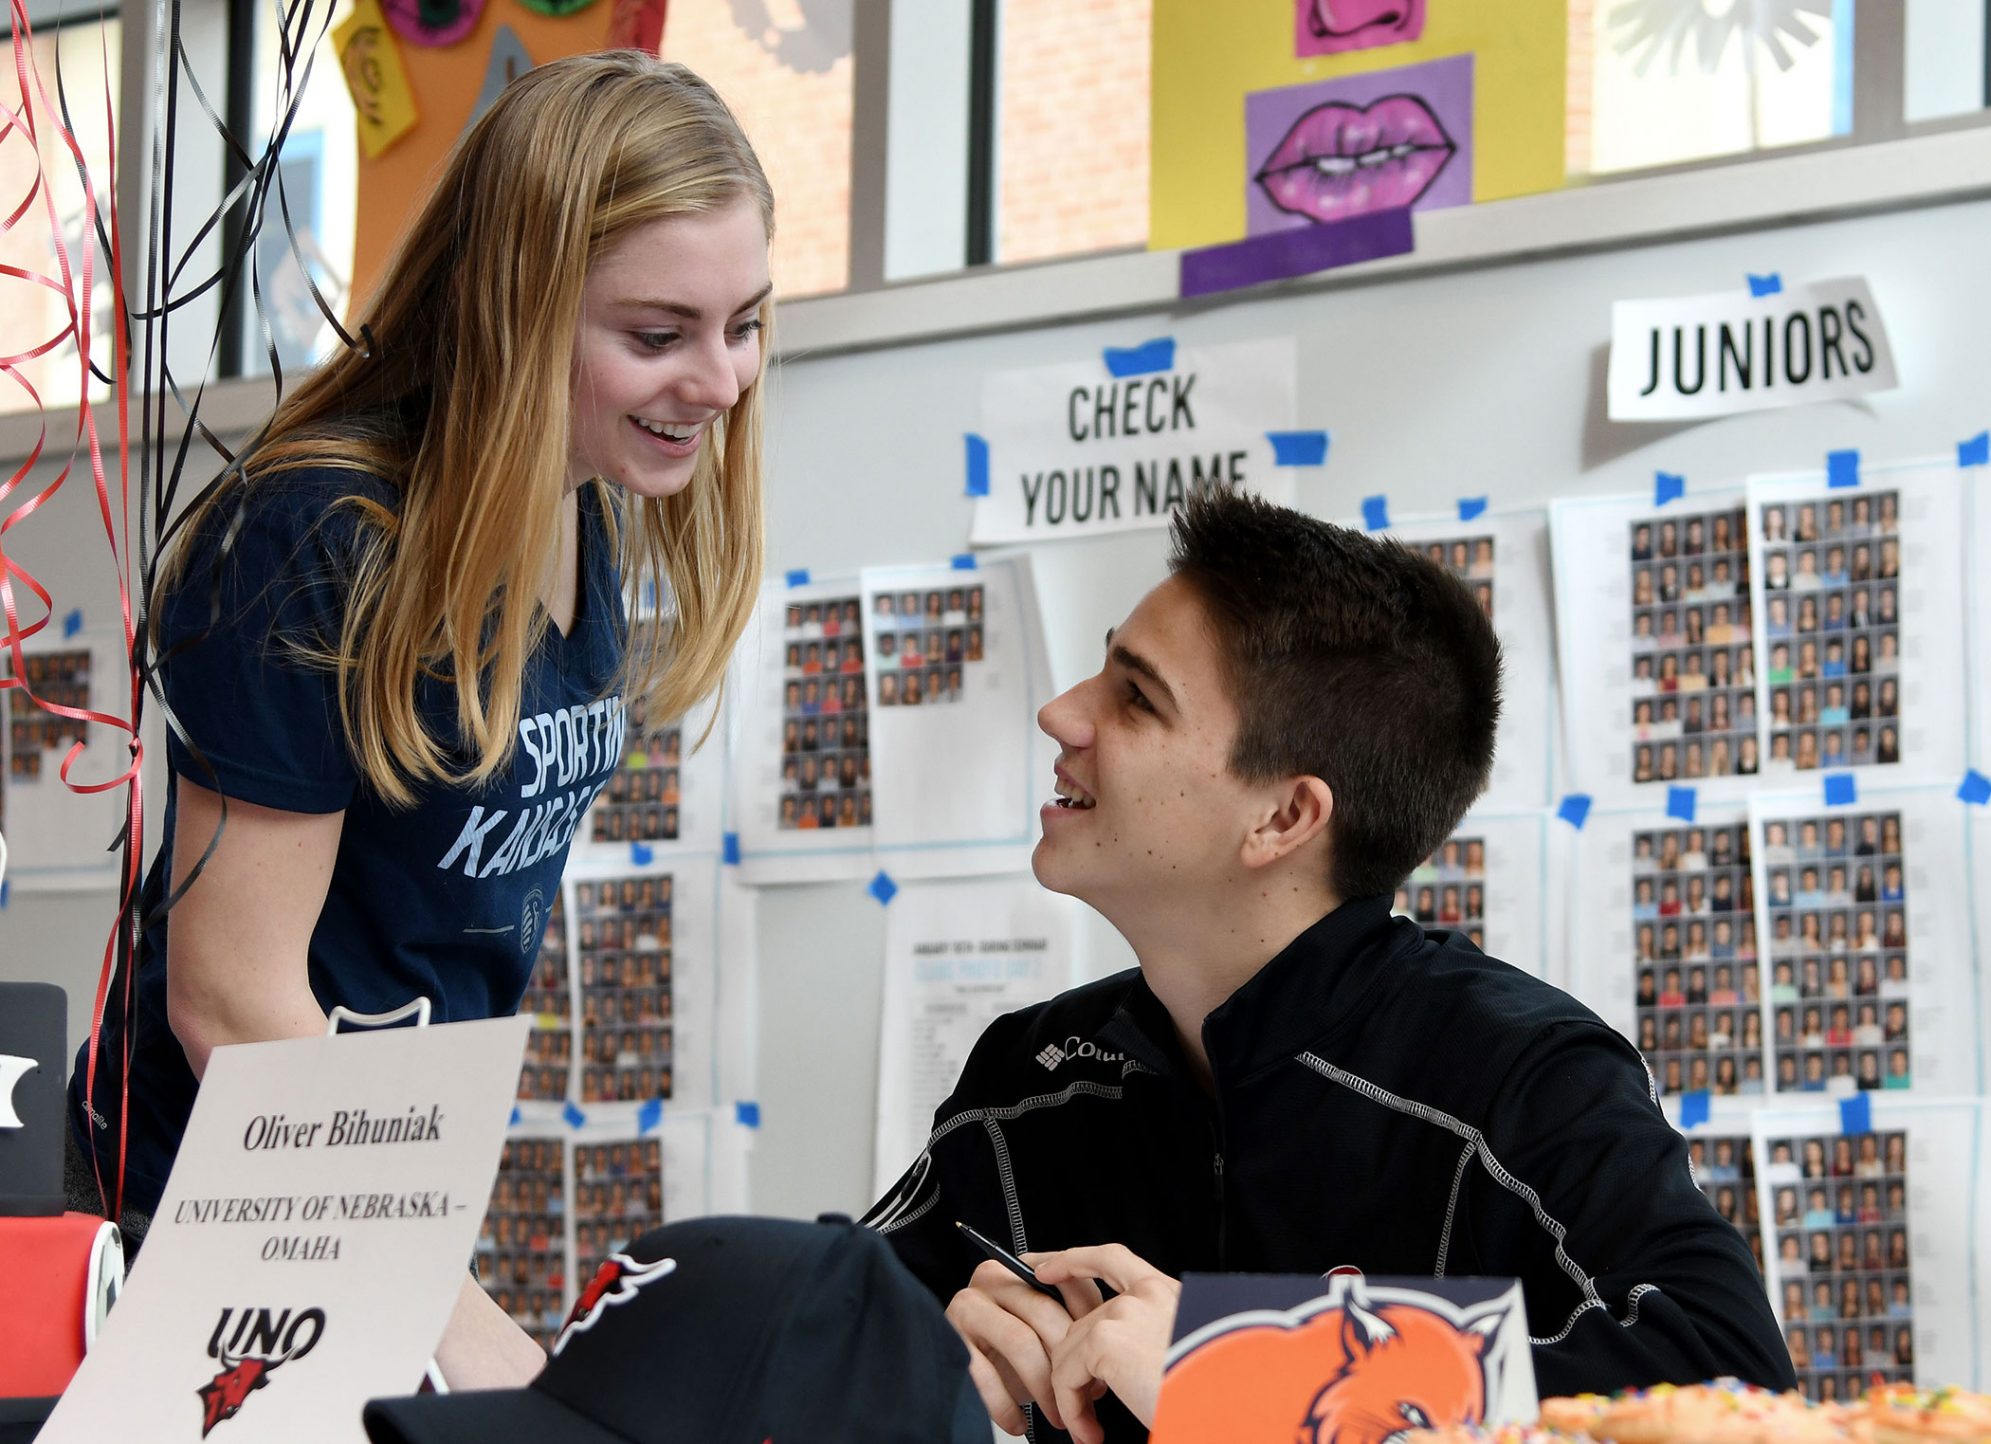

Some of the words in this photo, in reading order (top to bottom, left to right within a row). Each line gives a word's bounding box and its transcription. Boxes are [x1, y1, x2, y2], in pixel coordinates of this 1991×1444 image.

[1640, 298, 1874, 397] JUNIORS
[1069, 373, 1196, 442] CHECK
[1021, 465, 1121, 526] YOUR
[243, 1113, 323, 1150] Oliver
[326, 1104, 446, 1146] Bihuniak
[174, 1197, 298, 1224] UNIVERSITY
[302, 1195, 332, 1221] OF
[333, 1191, 449, 1220] NEBRASKA
[260, 1235, 341, 1262] OMAHA
[206, 1306, 326, 1361] UNO
